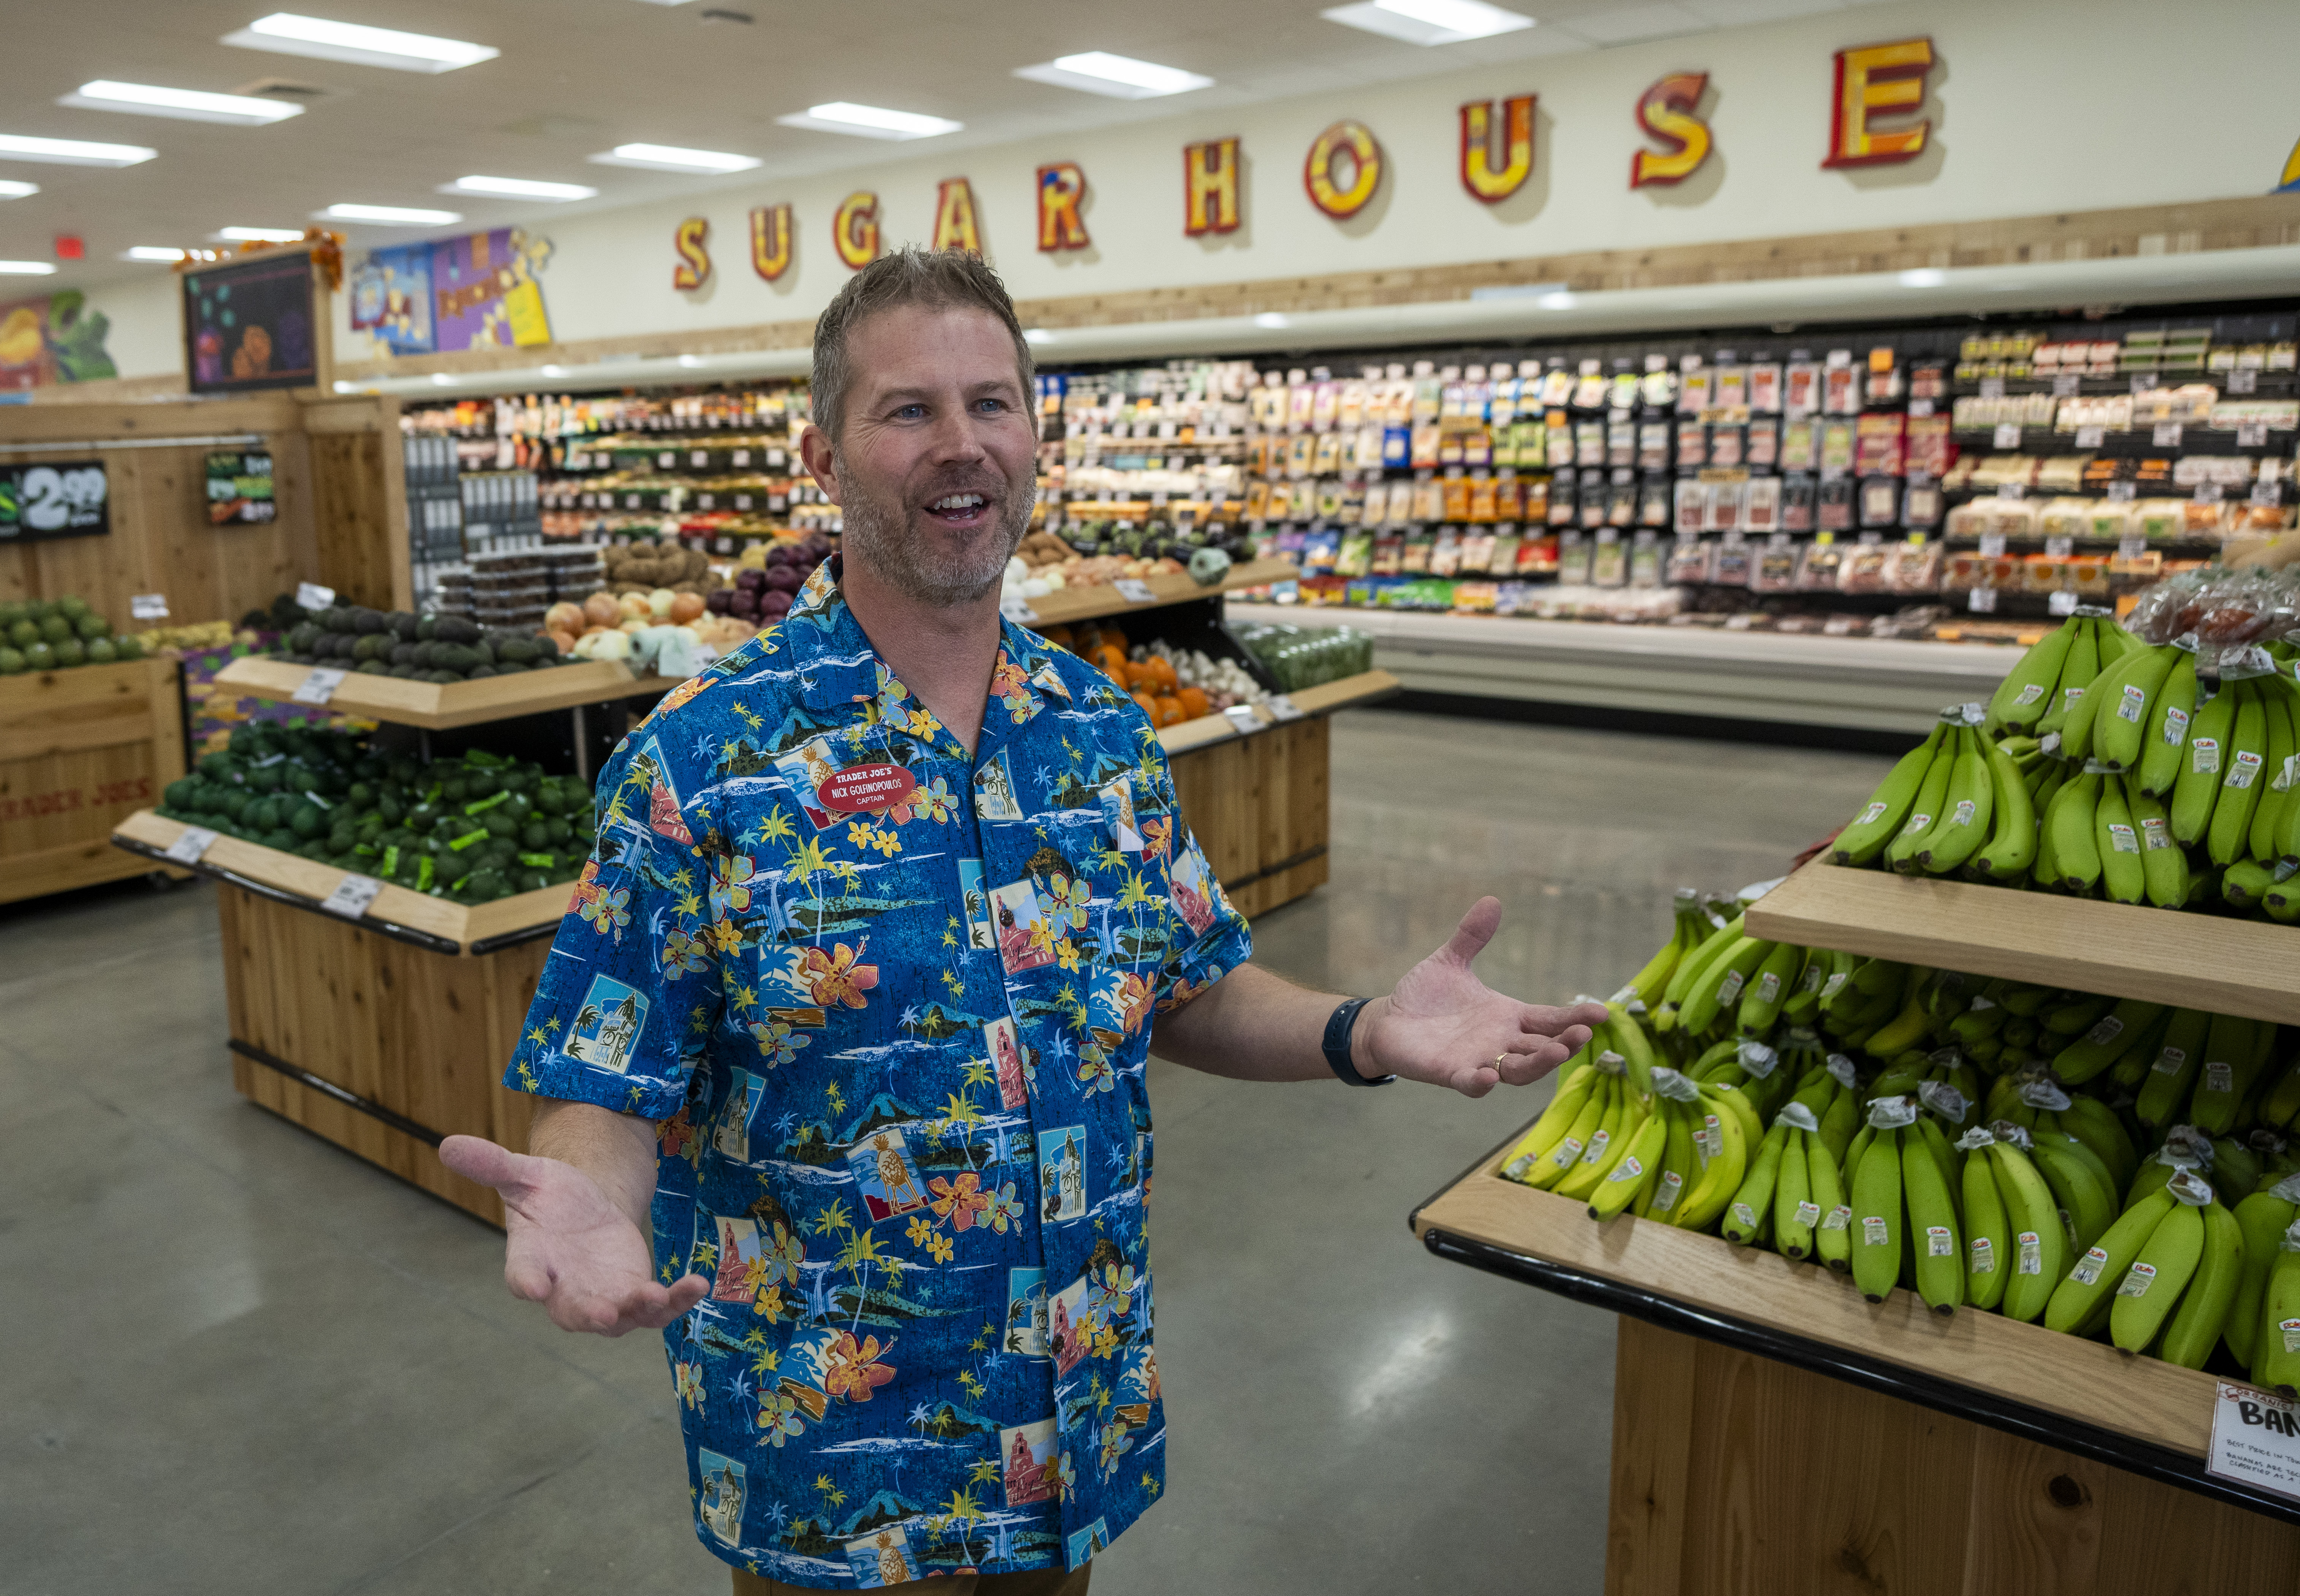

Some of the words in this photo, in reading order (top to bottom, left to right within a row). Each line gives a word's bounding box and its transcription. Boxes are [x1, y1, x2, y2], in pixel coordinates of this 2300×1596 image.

[674, 162, 1091, 290] SUGAR
[1184, 37, 1933, 237] HOUSE
[2240, 754, 2259, 762] Dole
[836, 772, 868, 783] TRADER
[869, 767, 892, 778] JOE'S
[831, 788, 848, 799] NICK
[850, 778, 902, 796] GOLFINOPOULOS
[856, 794, 885, 805] CAPTAIN
[2135, 1265, 2154, 1273] Dole
